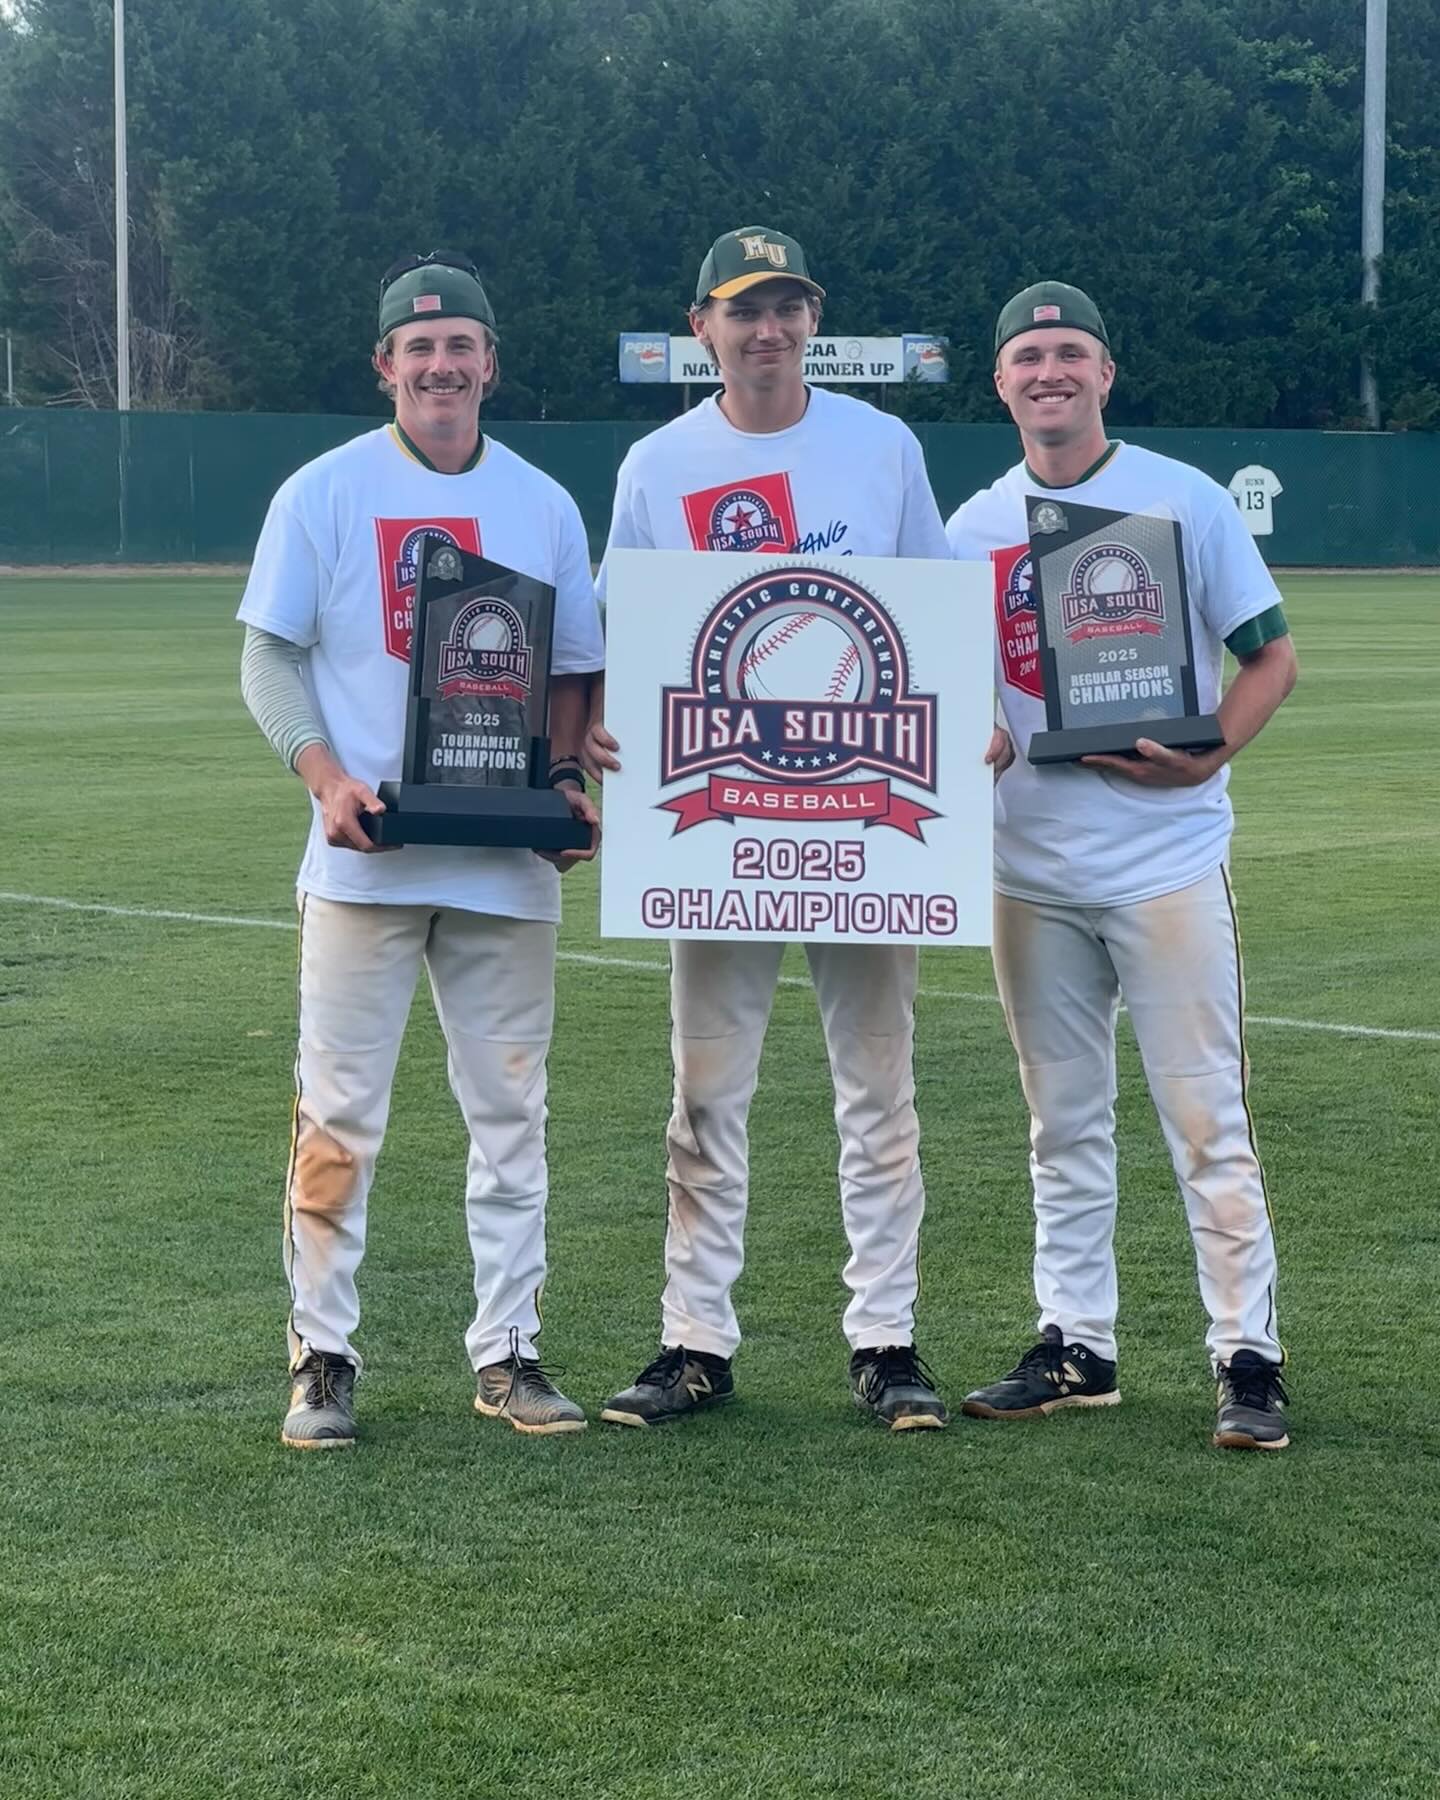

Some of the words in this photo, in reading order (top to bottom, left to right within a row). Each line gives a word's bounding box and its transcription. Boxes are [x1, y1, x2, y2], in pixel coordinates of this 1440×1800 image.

[738, 234, 788, 268] MU
[624, 342, 666, 353] PEPSI
[906, 342, 943, 353] PEPS
[803, 362, 864, 376] UNNER
[870, 362, 894, 376] UP
[1247, 491, 1264, 510] 13
[712, 535, 736, 551] USA
[740, 523, 778, 541] SOUTH
[798, 519, 848, 555] ANG
[401, 566, 416, 582] US
[1008, 593, 1029, 610] USA
[1068, 597, 1099, 619] USA
[1105, 591, 1156, 610] SOUTH
[1015, 619, 1037, 636] CONF
[707, 589, 772, 694] ATHLETIC
[789, 582, 893, 698] CONFERENCE
[1007, 632, 1039, 658] CHAM
[447, 651, 474, 670] USA
[481, 652, 525, 675] SOUTH
[1098, 648, 1138, 663] 2025
[1071, 670, 1122, 687] REGULAR
[1123, 665, 1169, 682] SEASON
[1069, 678, 1174, 705] CHAMPIONS
[464, 713, 501, 727] 2025
[440, 733, 520, 750] TOURNAMENT
[681, 706, 761, 758] USA
[784, 710, 918, 764] SOUTH
[432, 749, 527, 770] CHAMPIONS
[723, 787, 876, 809] BASEBALL
[732, 837, 865, 881] 2025
[642, 887, 958, 935] CHAMPIONS
